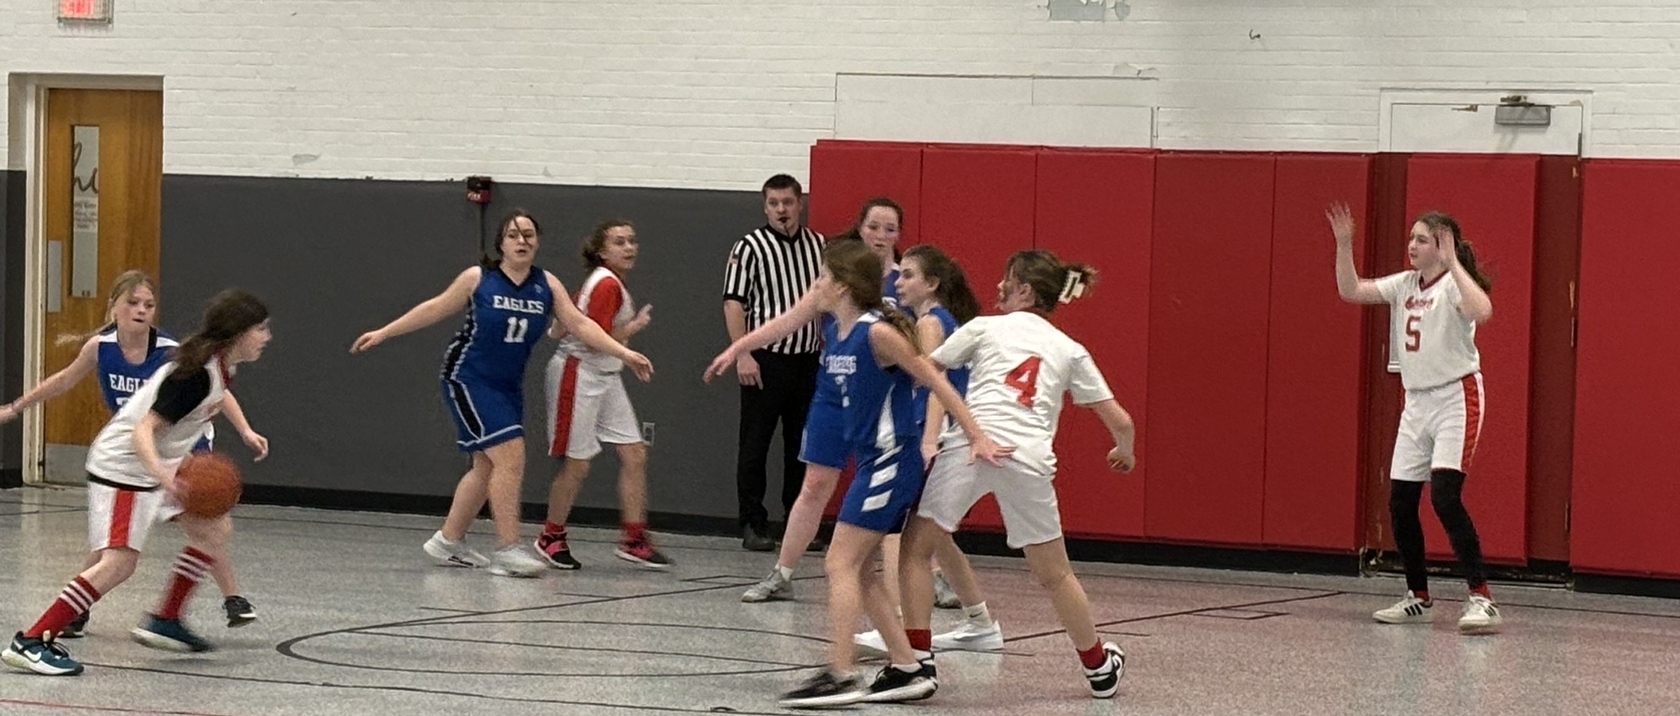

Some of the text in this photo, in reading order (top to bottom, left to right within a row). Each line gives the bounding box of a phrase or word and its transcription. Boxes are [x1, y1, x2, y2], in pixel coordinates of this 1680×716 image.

[493, 295, 545, 315] EAGLES
[504, 316, 528, 343] 11
[1405, 315, 1421, 352] 5
[109, 373, 149, 393] EAGL
[1004, 355, 1041, 408] 4
